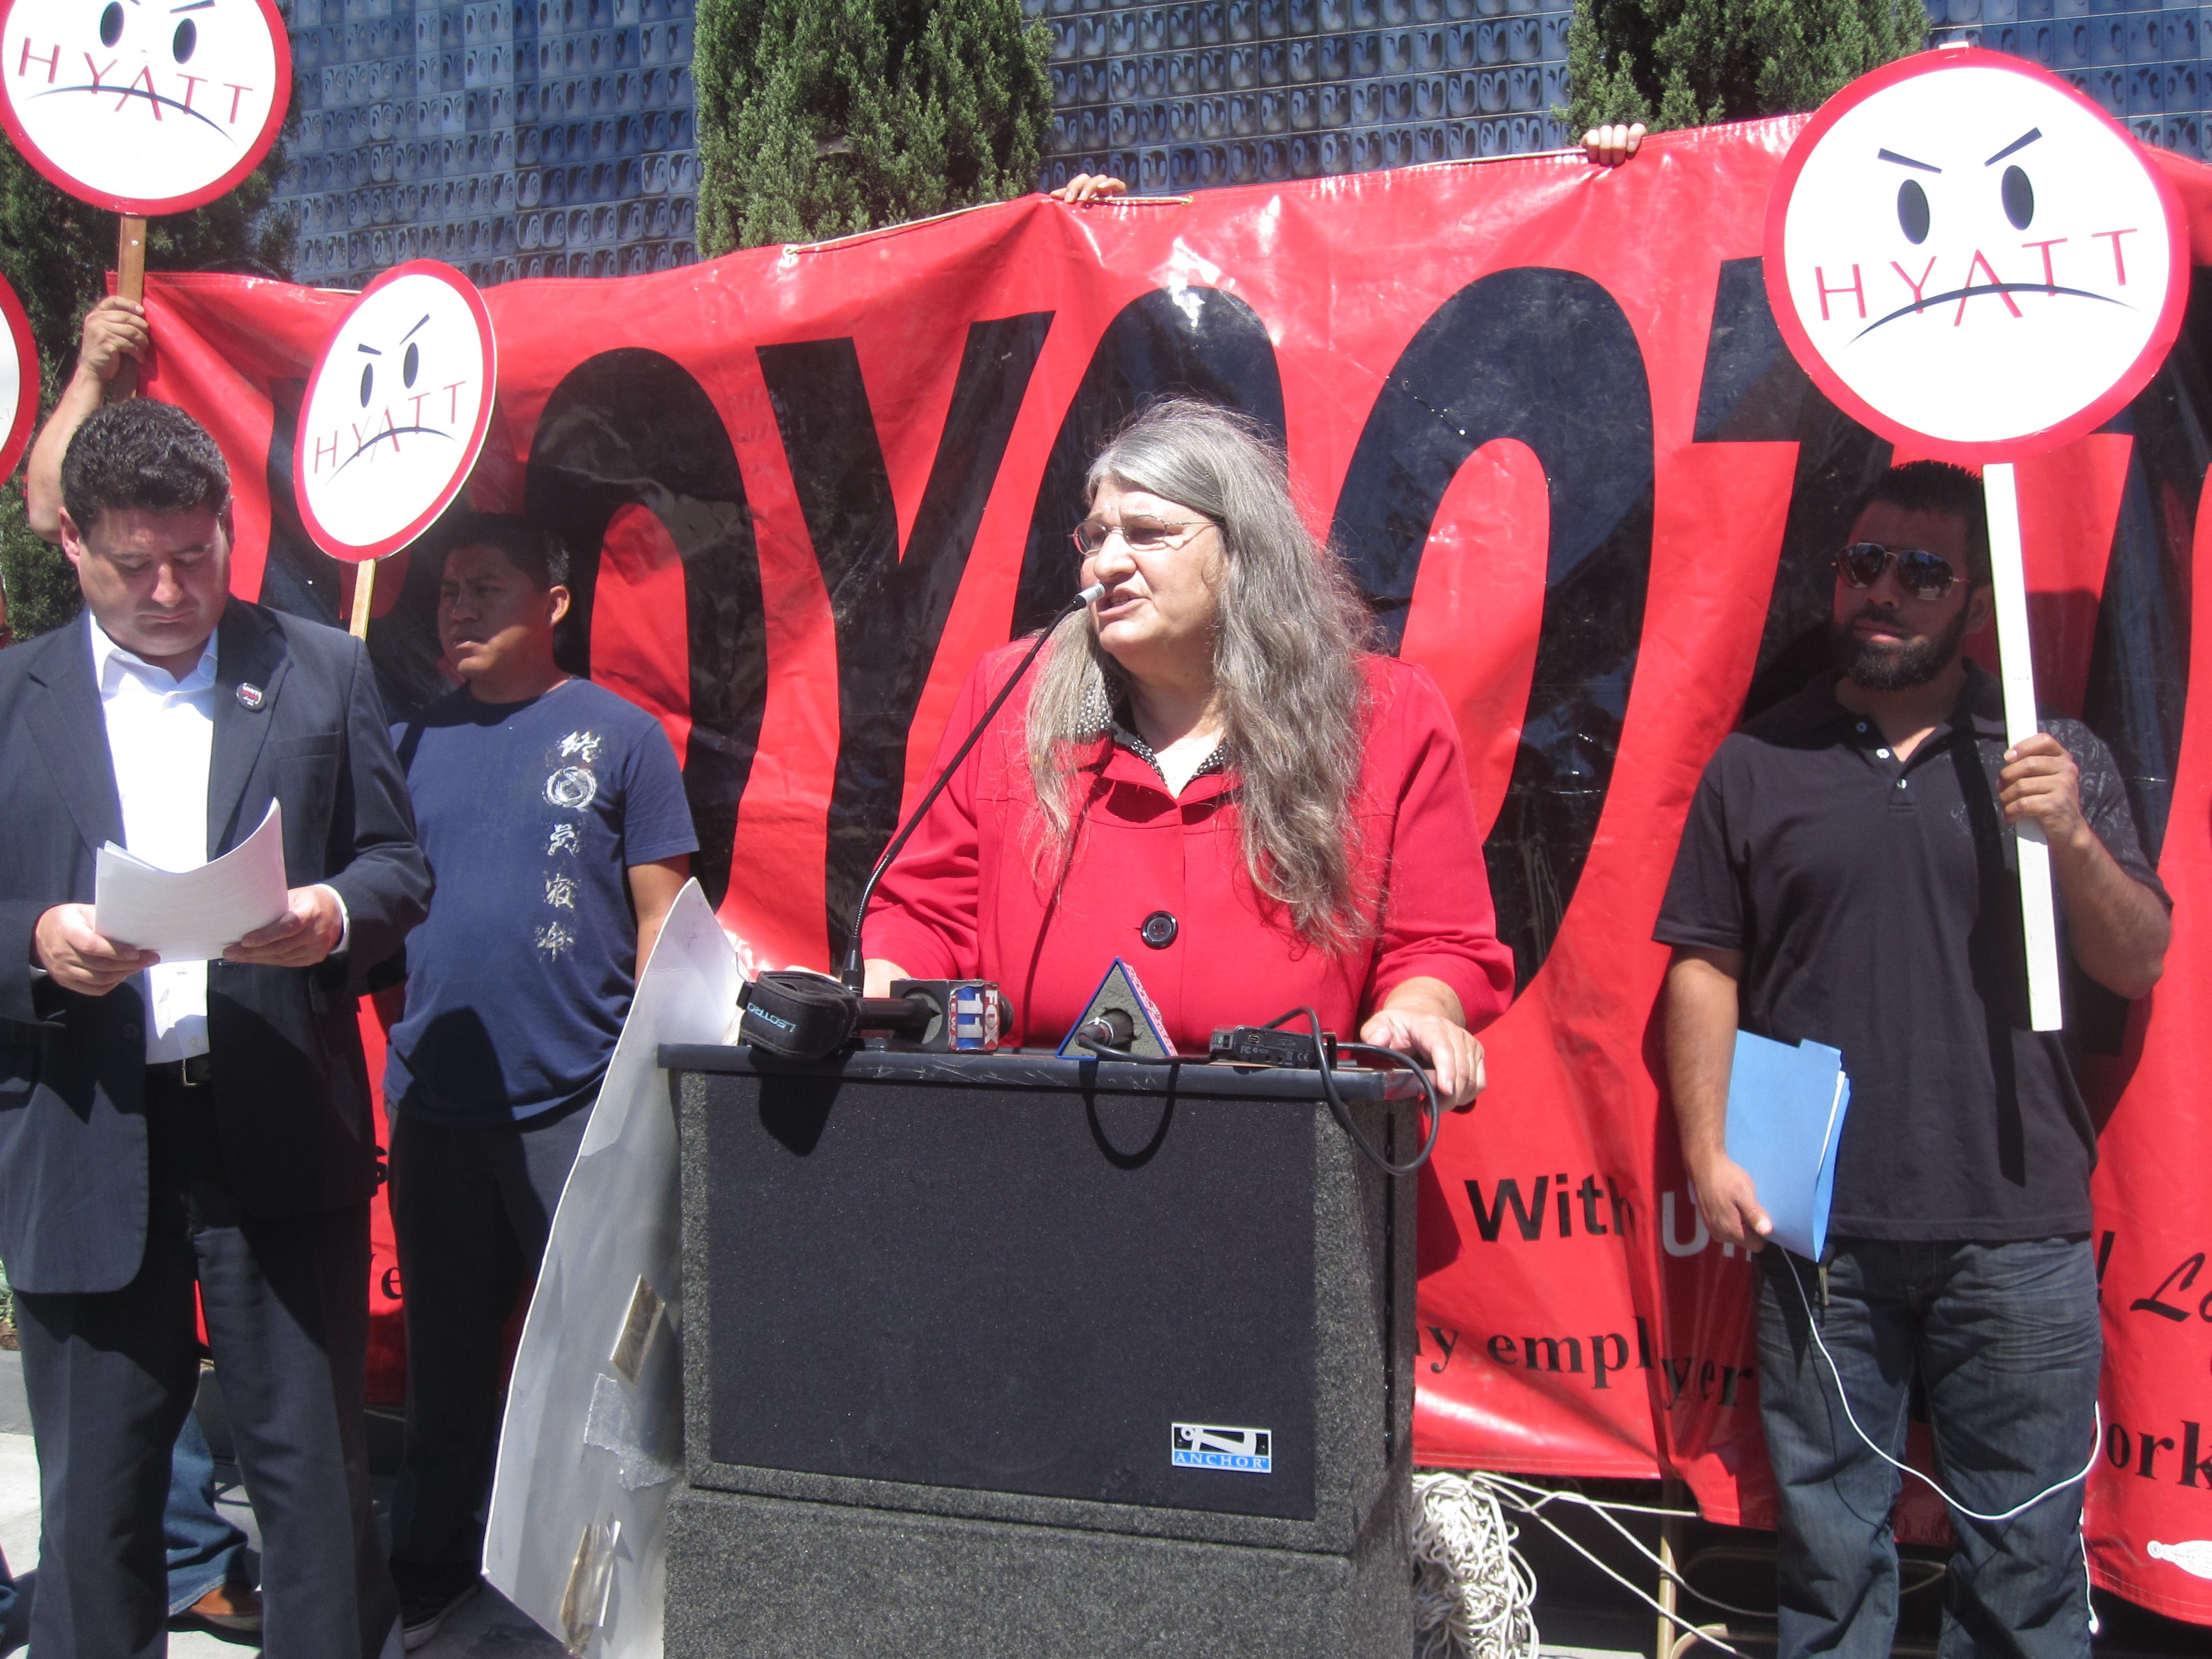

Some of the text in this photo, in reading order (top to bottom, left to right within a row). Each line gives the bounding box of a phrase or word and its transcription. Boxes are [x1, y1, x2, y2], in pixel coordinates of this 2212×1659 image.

[18, 37, 254, 123] HYATT
[1814, 228, 2138, 327] HYATT
[314, 380, 467, 474] HYATT
[957, 993, 981, 1038] 11
[984, 989, 999, 1045] FOX
[1464, 1173, 1637, 1245] With
[1175, 1452, 1263, 1469] ANCHOR
